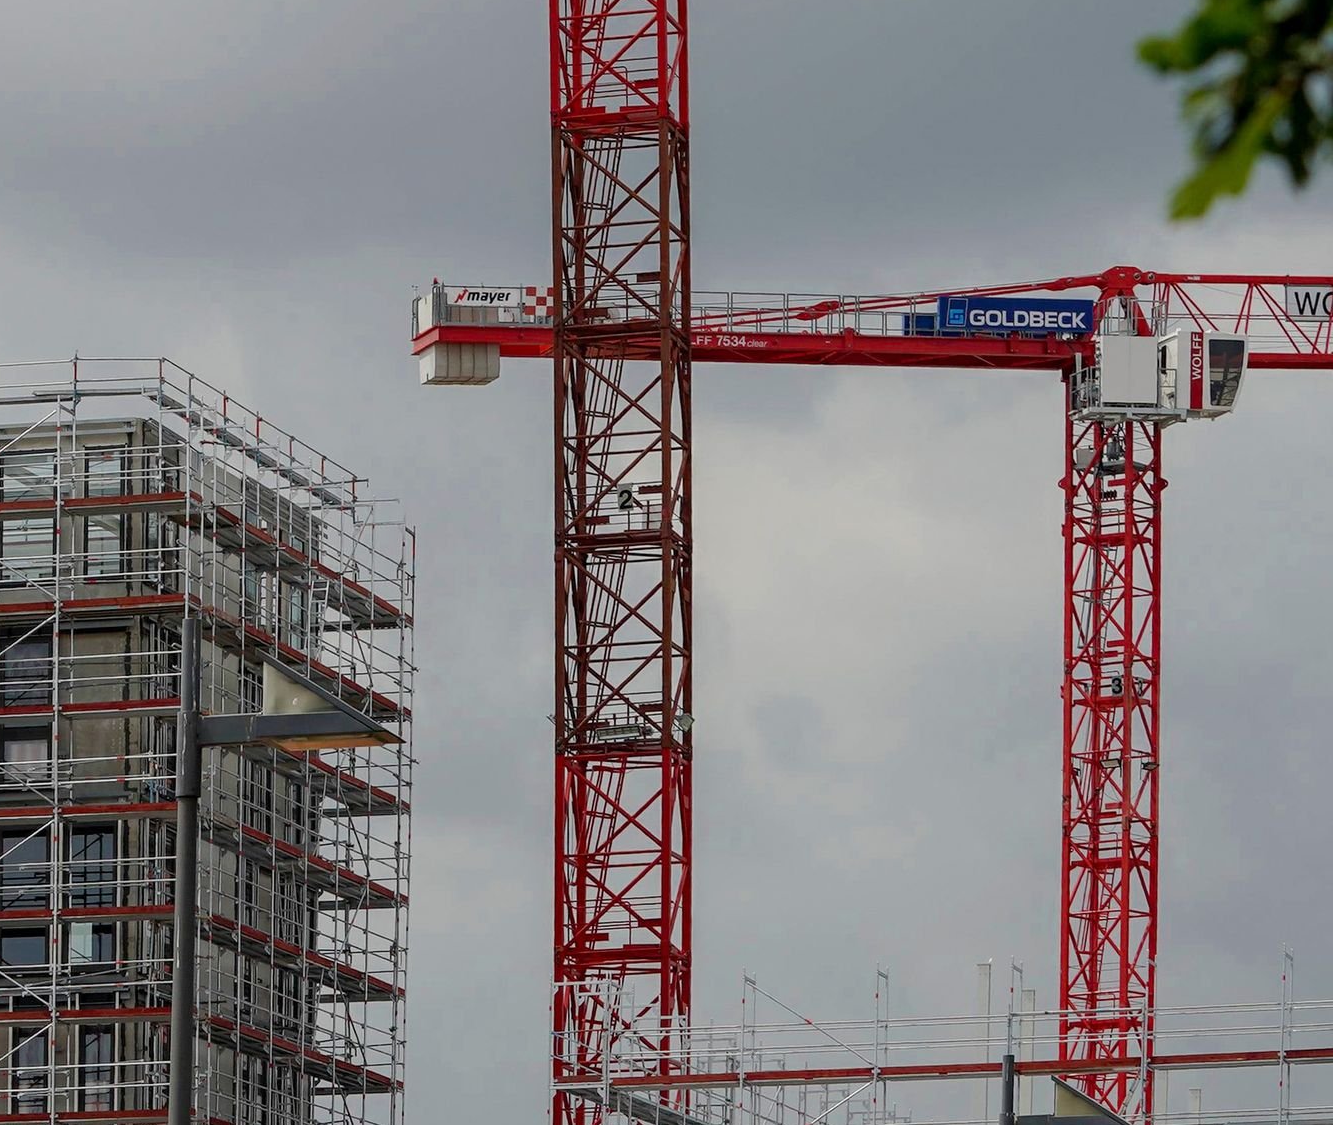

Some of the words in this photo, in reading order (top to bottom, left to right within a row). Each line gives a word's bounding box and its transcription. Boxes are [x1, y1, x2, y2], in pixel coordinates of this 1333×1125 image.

[467, 291, 511, 304] mayer
[969, 309, 1087, 329] GOLDBECK
[716, 335, 746, 347] 7534
[747, 338, 768, 348] clear
[1192, 333, 1202, 380] WOLFF
[619, 489, 633, 510] 2
[1111, 677, 1122, 694] 3
